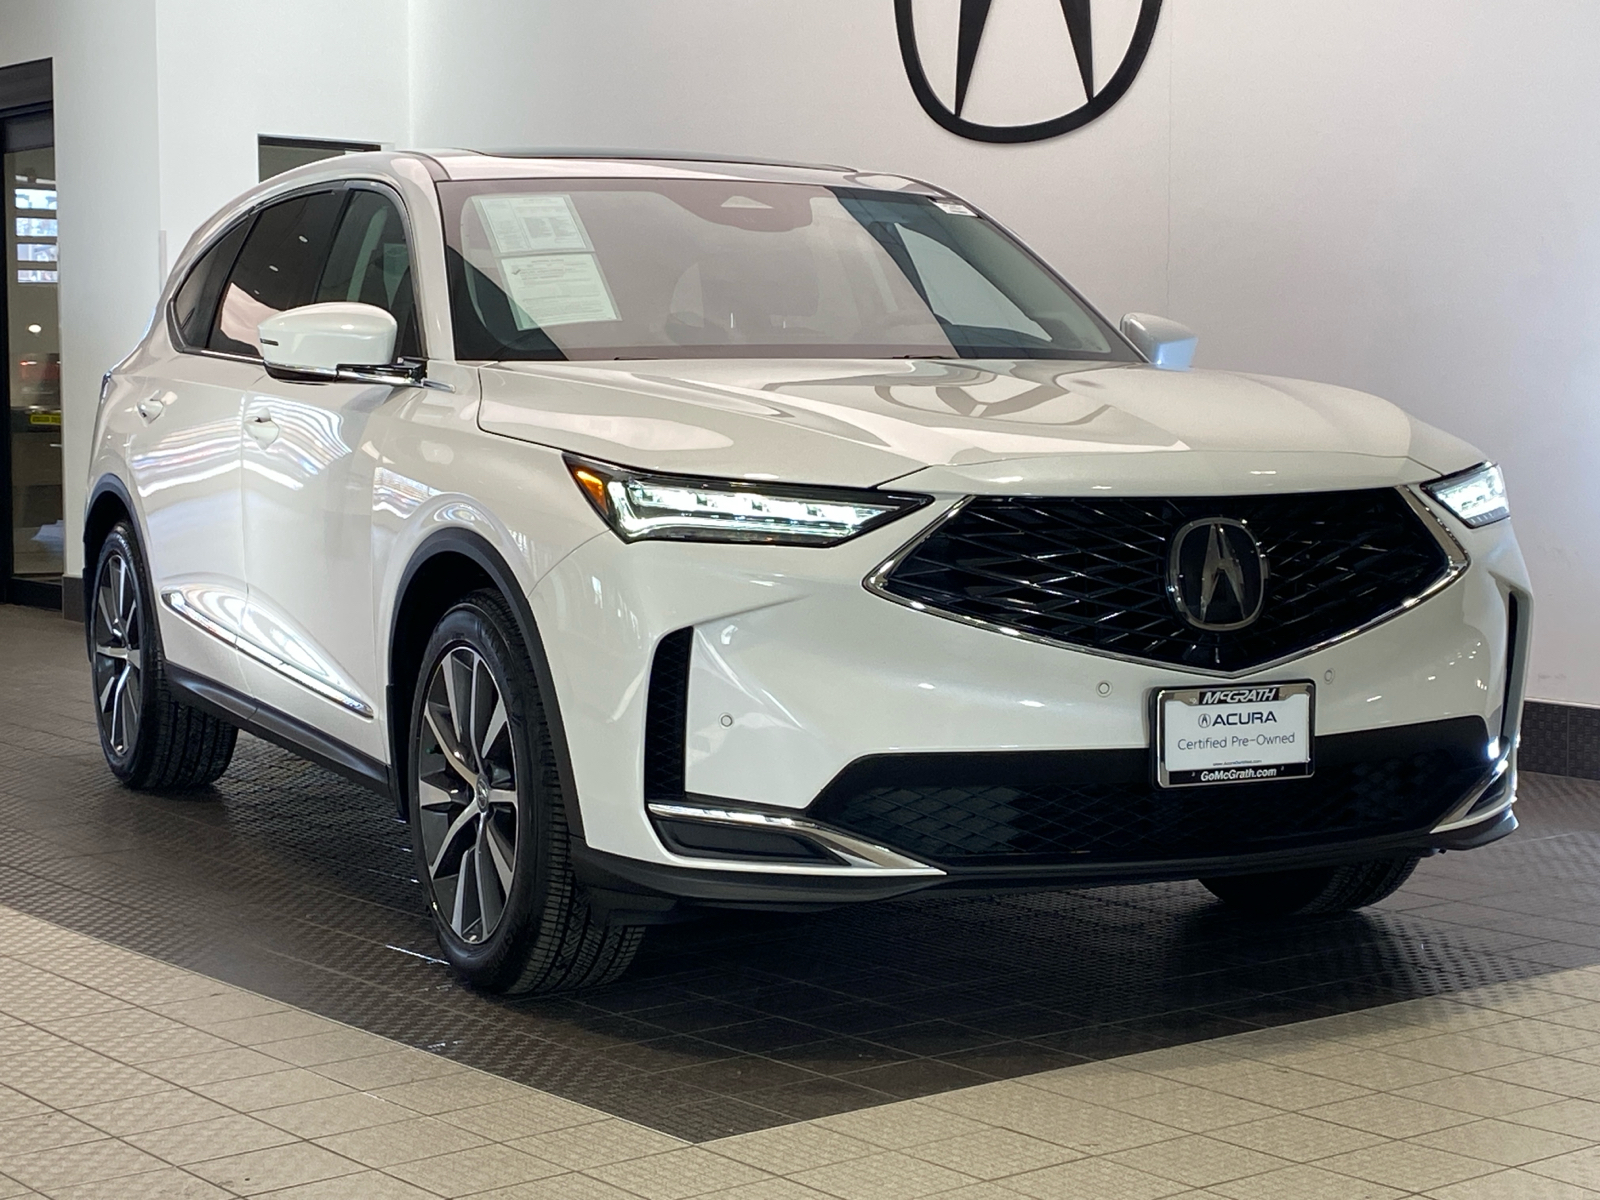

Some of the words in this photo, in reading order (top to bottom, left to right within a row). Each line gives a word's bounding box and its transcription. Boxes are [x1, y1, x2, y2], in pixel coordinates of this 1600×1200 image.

[1212, 711, 1277, 727] ACURA
[1178, 737, 1227, 751] Certified
[1231, 733, 1295, 747] Pre-Owned
[1200, 767, 1277, 782] GoMcGrath.com
